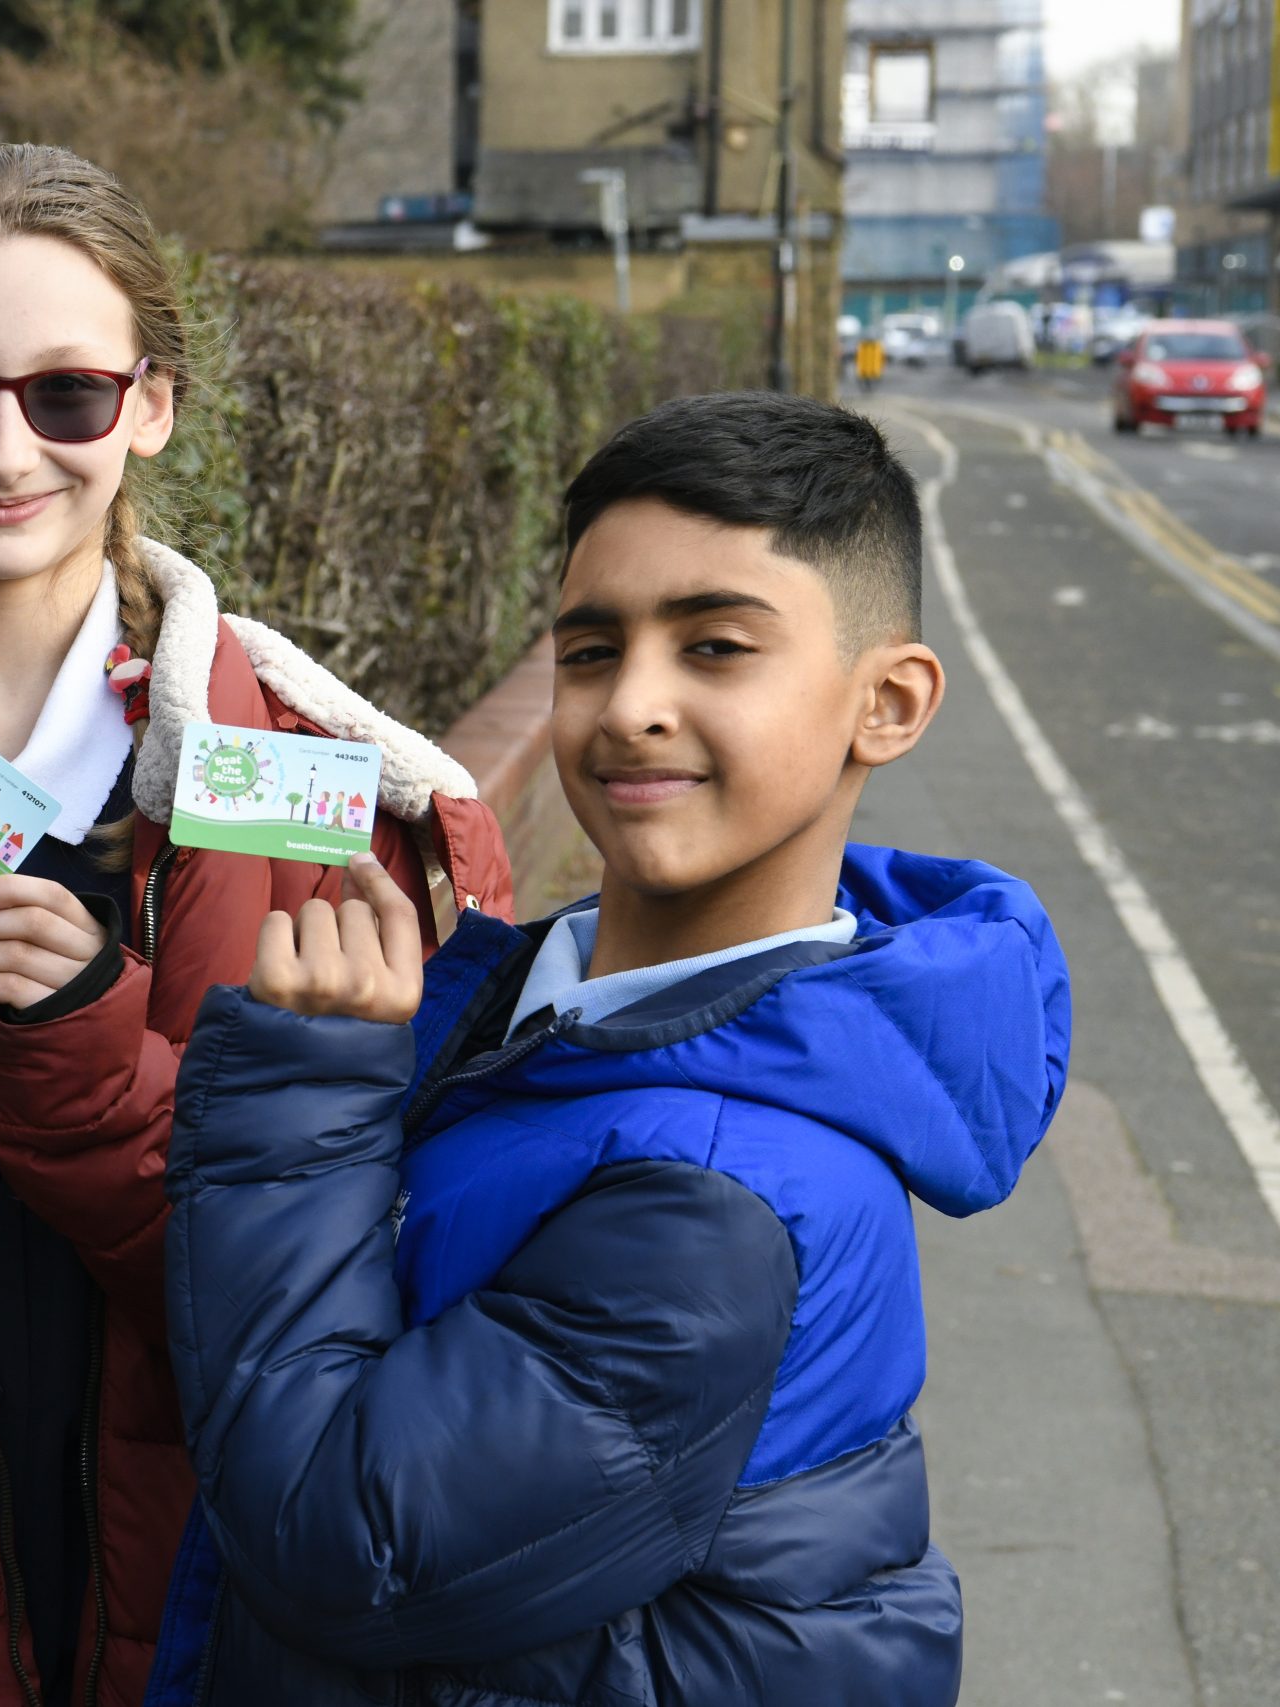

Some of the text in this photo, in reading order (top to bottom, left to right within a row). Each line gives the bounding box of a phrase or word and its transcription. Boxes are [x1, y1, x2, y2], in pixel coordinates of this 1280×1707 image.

[214, 754, 243, 767] Beat
[334, 752, 369, 763] 4434530
[222, 764, 242, 776] the
[212, 772, 247, 785] Street
[21, 790, 47, 811] 4121071
